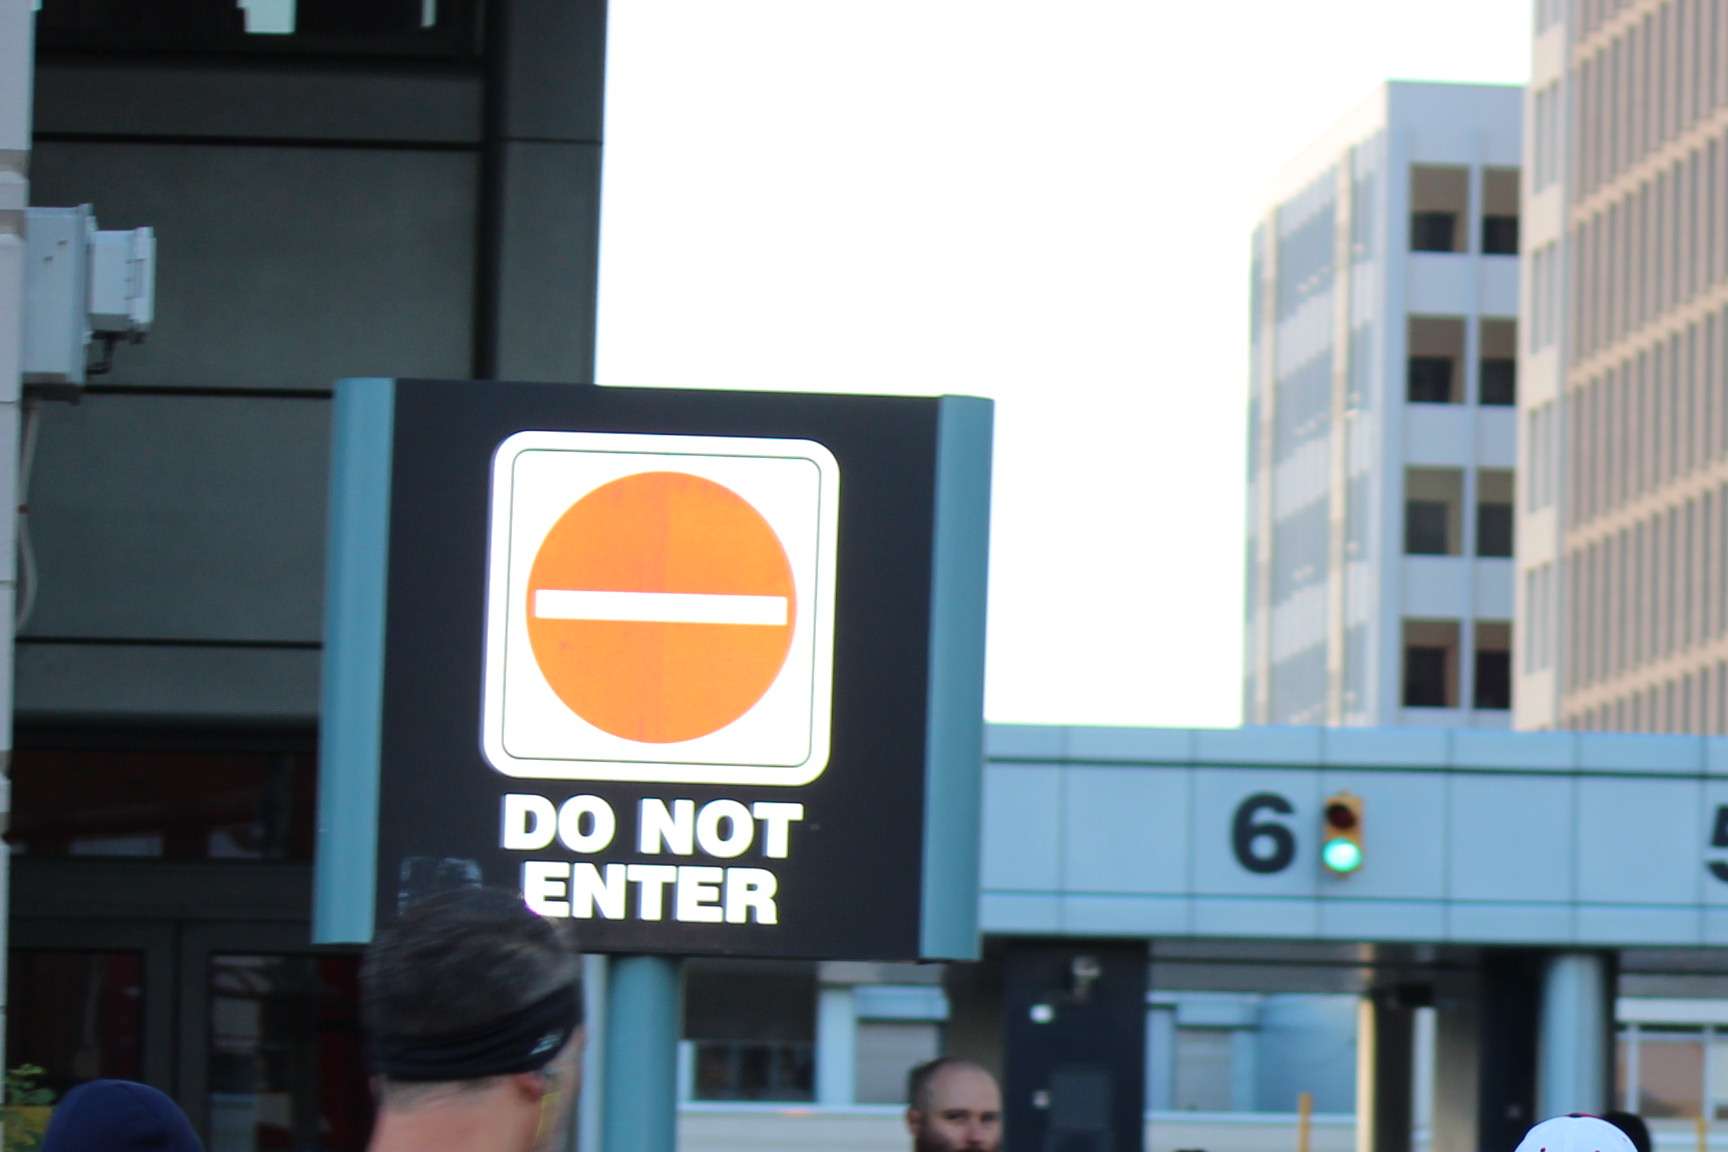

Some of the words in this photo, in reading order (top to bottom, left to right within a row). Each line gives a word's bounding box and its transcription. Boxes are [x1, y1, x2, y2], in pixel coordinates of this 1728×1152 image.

[502, 793, 616, 854] DO
[639, 797, 804, 858] NOT
[1231, 791, 1297, 874] 6
[523, 860, 778, 924] ENTER
